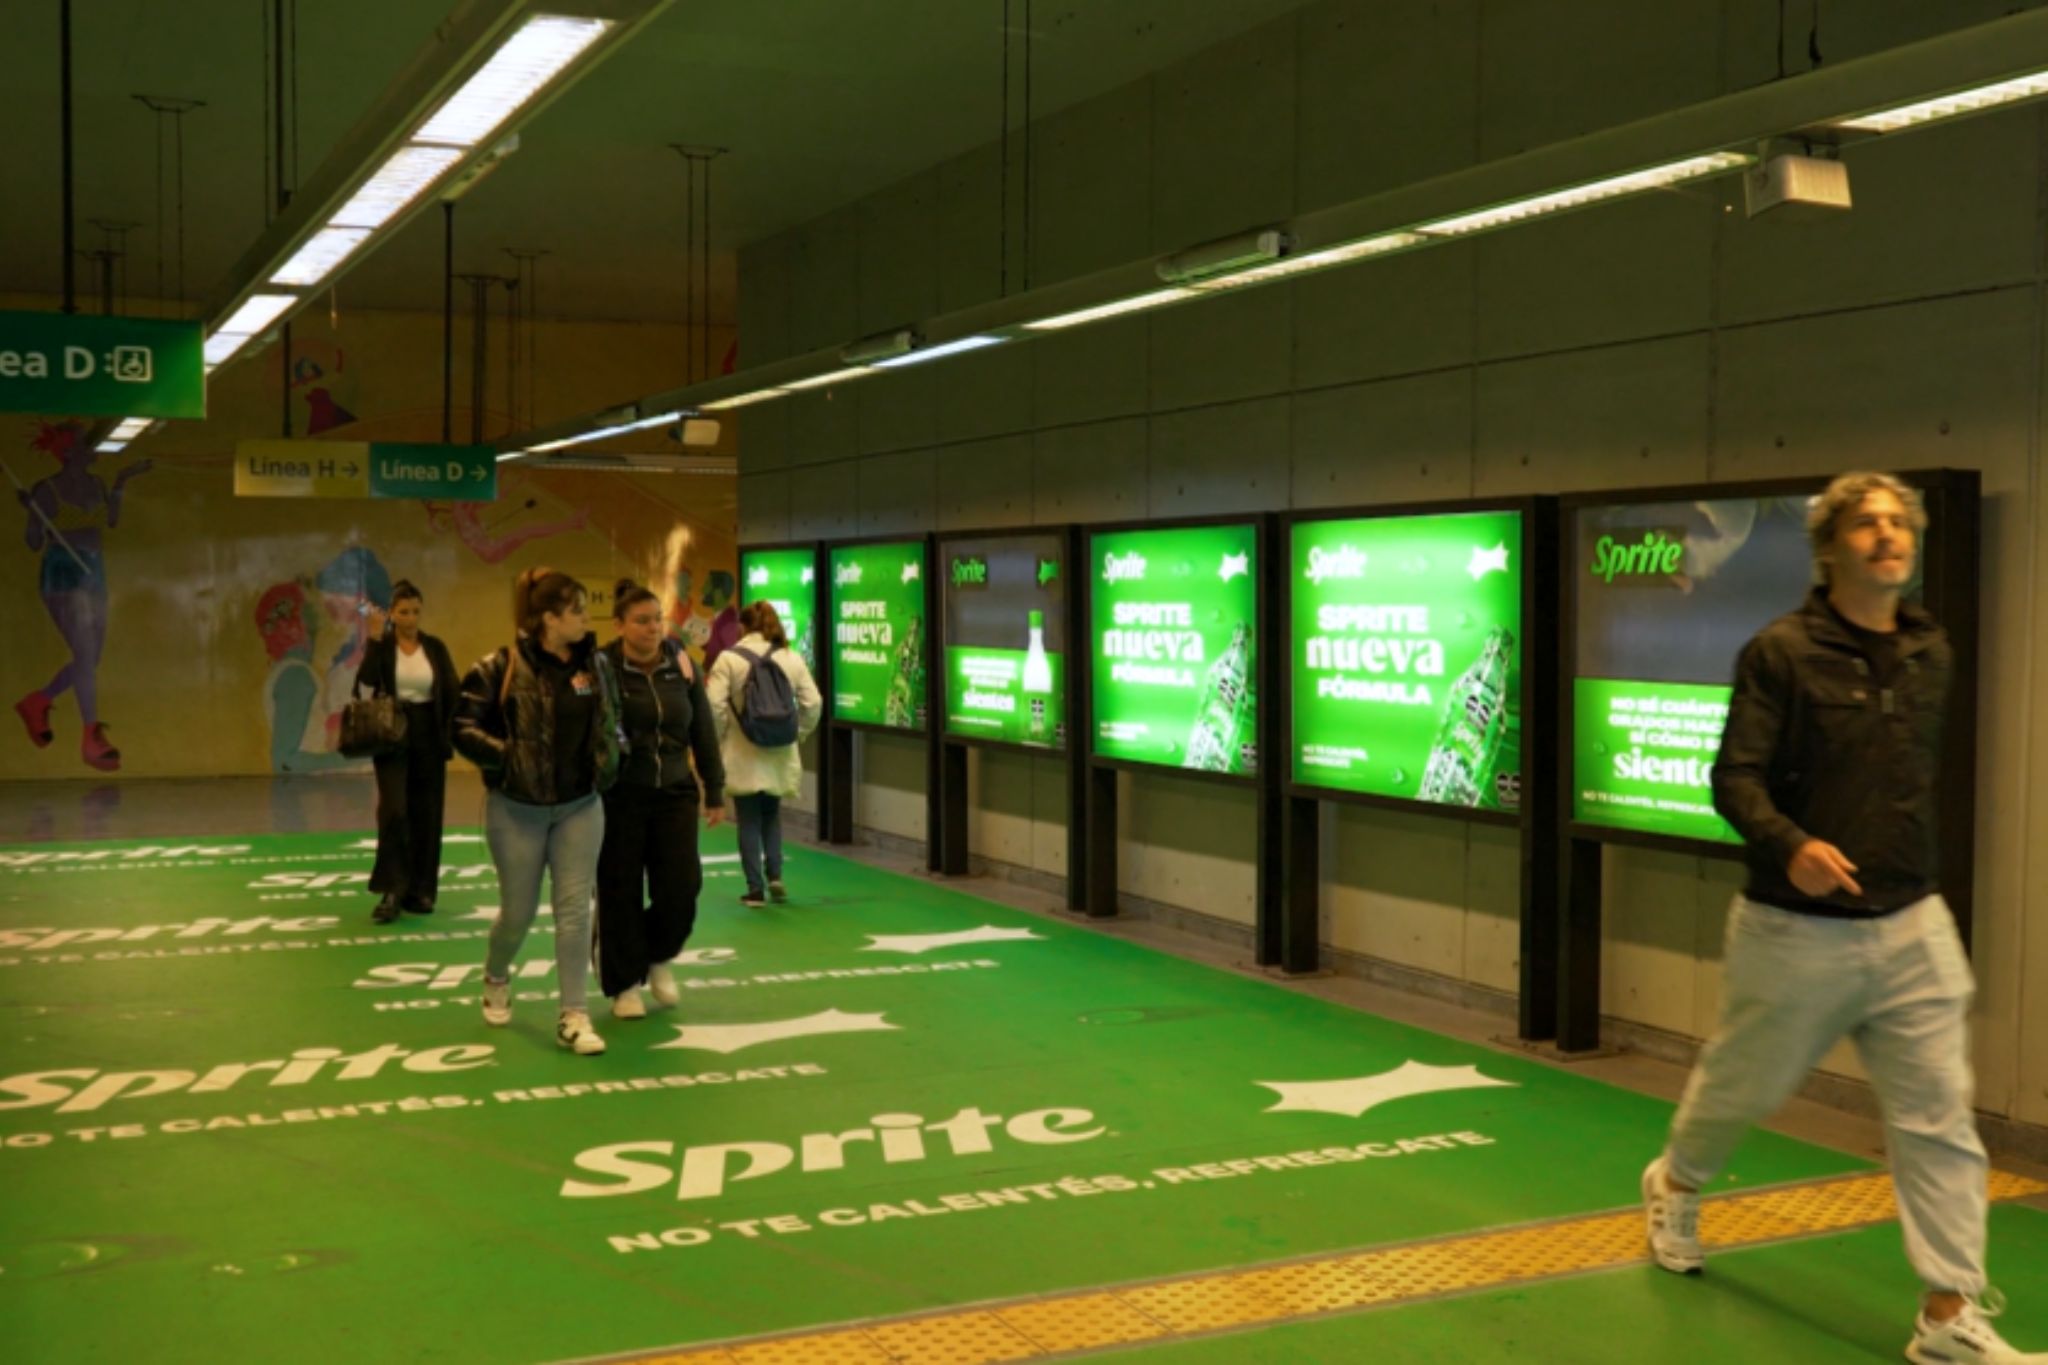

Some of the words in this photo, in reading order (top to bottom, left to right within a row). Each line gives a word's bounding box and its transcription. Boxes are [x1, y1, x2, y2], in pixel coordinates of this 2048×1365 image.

[64, 346, 96, 379] D
[249, 457, 310, 478] Línea
[318, 460, 335, 478] H
[381, 459, 441, 482] Línea
[447, 461, 464, 480] D
[952, 557, 986, 587] Sprite
[1591, 533, 1682, 583] Sprite
[841, 601, 886, 619] SPRITE
[1112, 603, 1192, 626] SPRITE
[1318, 604, 1429, 633] SPRITE
[837, 623, 892, 644] nueva
[1103, 629, 1205, 662] nueva
[1306, 636, 1445, 676] nueva
[1317, 674, 1433, 705] FÓRMULA
[753, 958, 1000, 985] REFRESCATE
[0, 1043, 497, 1114] Sprite
[66, 1124, 147, 1143] TE
[160, 1094, 484, 1133] CALENTÉS,
[493, 1063, 828, 1103] REFRESCATE
[559, 1106, 1108, 1200] Sprite
[607, 1226, 713, 1254] NO
[717, 1214, 812, 1238] TE
[818, 1173, 1157, 1227] CALENTÉS,
[1152, 1129, 1496, 1185] REFRESCATE
